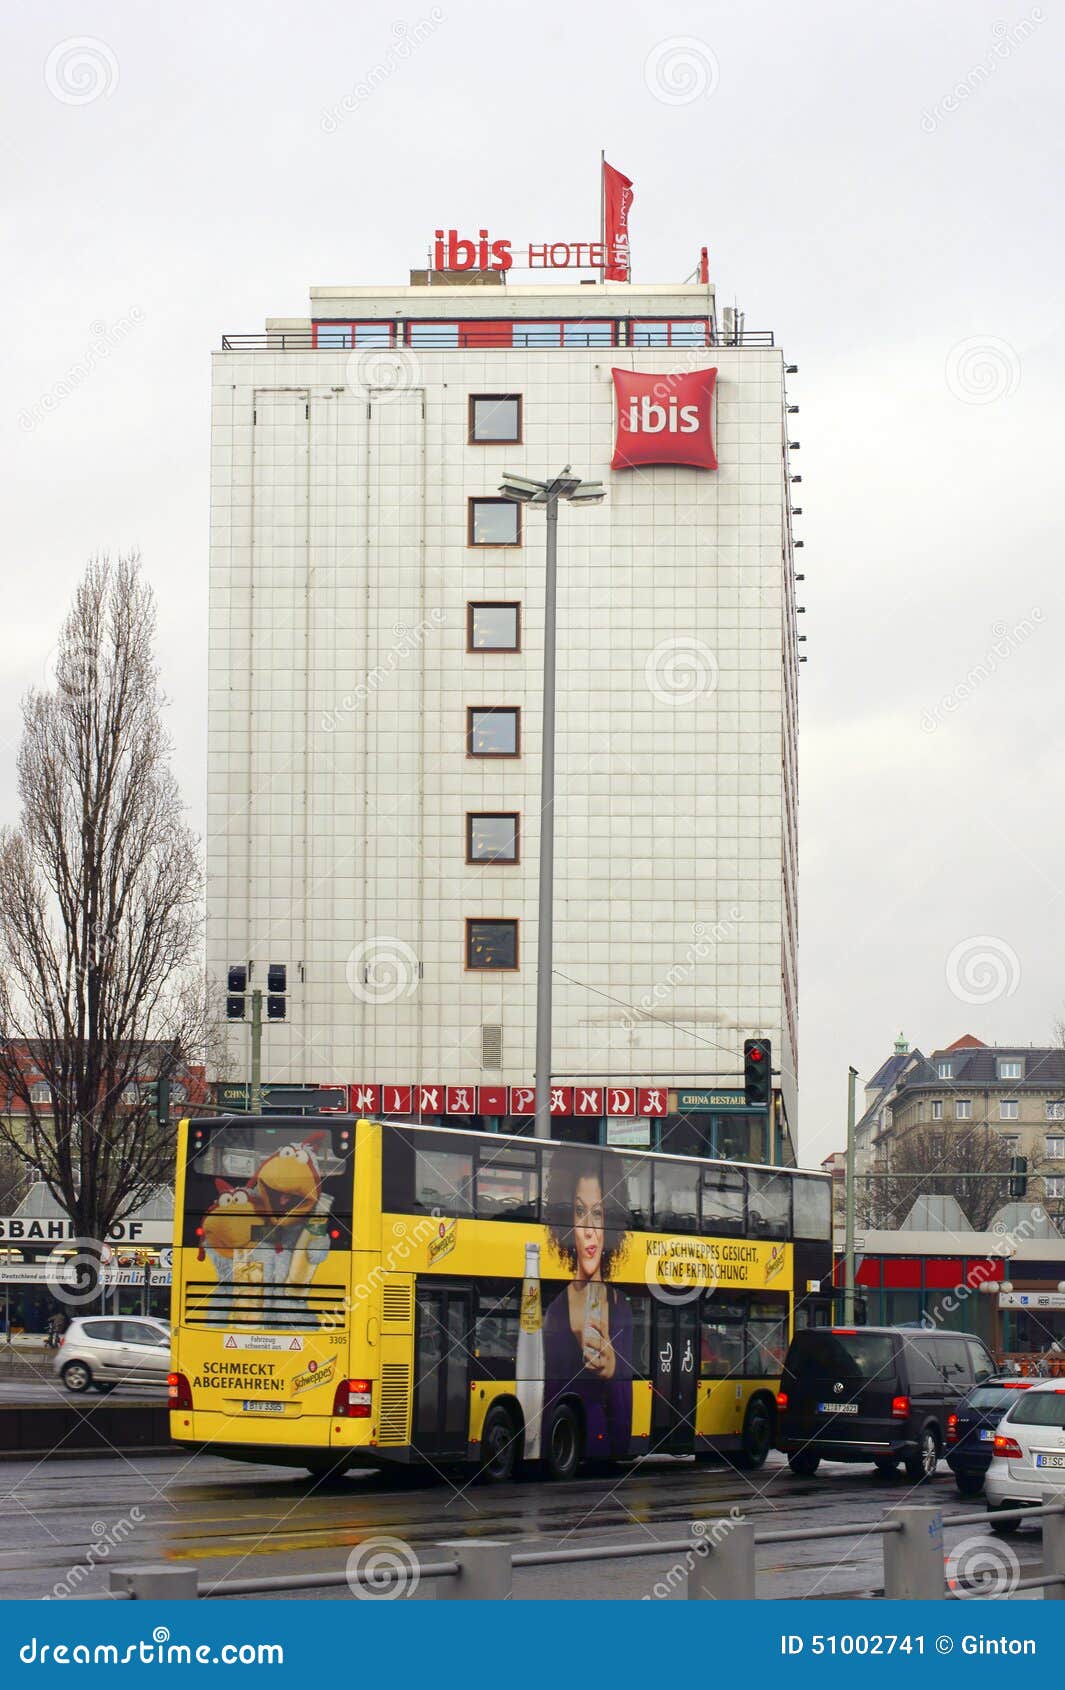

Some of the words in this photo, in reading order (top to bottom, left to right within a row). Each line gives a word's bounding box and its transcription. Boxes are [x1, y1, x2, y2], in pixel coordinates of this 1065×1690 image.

[435, 229, 513, 271] ibis
[528, 243, 607, 268] HOTE
[629, 396, 700, 433] ibis
[710, 1096, 746, 1106] RESTAUR
[646, 1239, 668, 1256] KEIN
[670, 1242, 720, 1260] SCHWEPPES
[722, 1246, 759, 1264] GESICHT,
[657, 1261, 684, 1277] KEINE
[686, 1263, 749, 1281] ERFRISCHUNG!
[329, 1336, 347, 1345] 3305
[203, 1362, 276, 1376] SCHMECKT
[193, 1376, 285, 1391] ABGEFAHREN!
